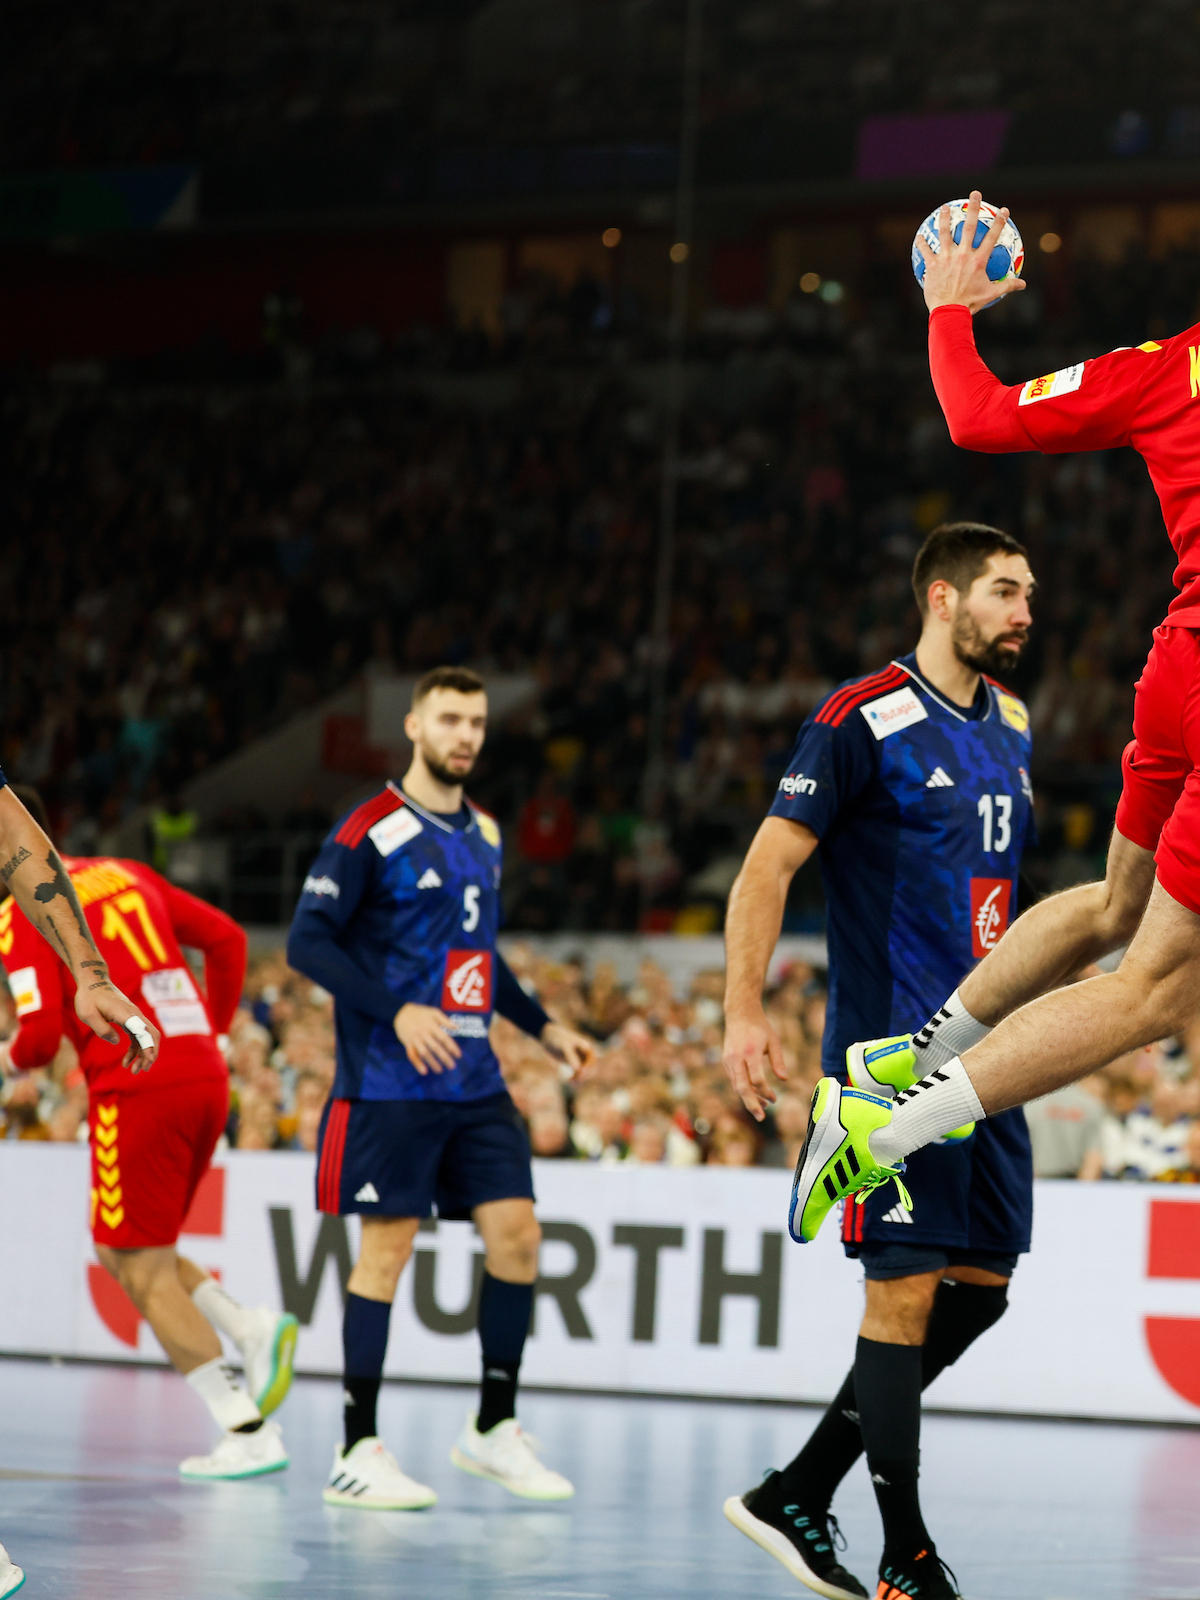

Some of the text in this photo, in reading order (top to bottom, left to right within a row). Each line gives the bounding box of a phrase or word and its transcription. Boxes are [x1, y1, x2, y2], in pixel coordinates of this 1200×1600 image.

[977, 794, 1012, 852] 13
[102, 888, 169, 971] 17
[462, 885, 480, 932] 5
